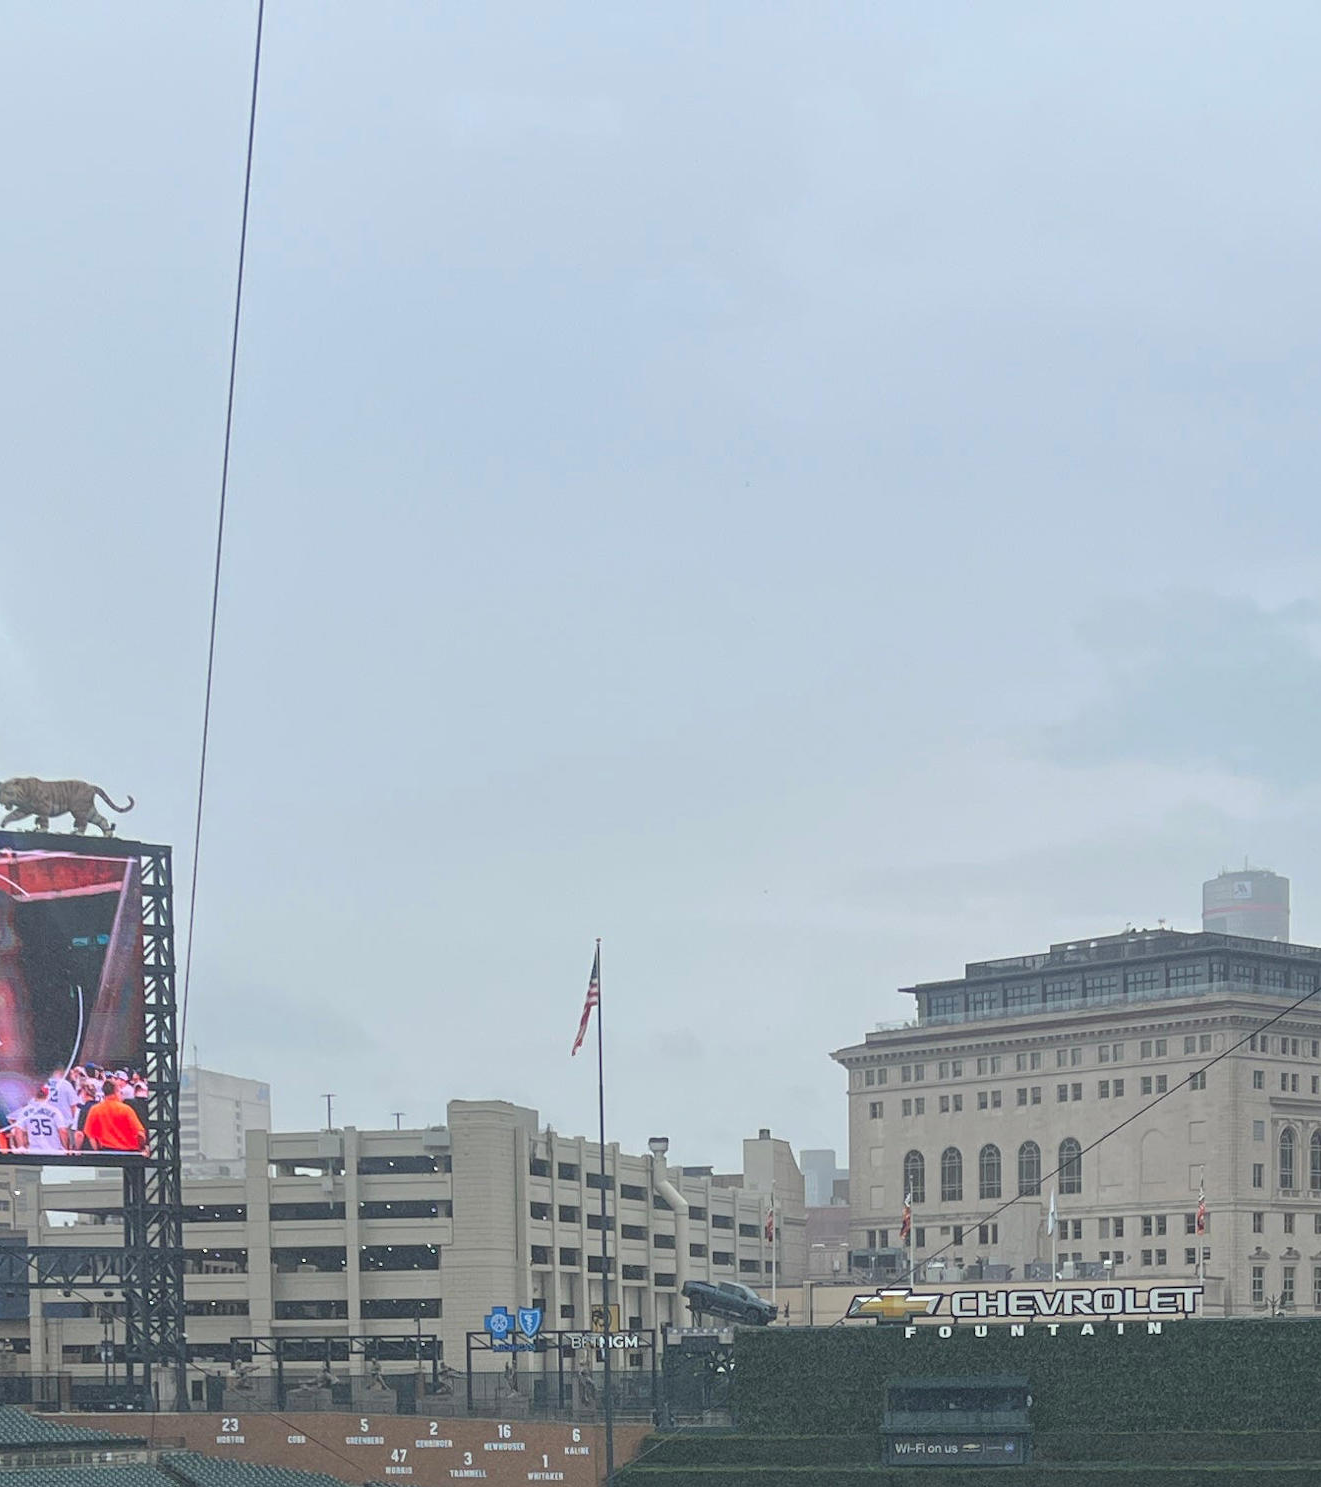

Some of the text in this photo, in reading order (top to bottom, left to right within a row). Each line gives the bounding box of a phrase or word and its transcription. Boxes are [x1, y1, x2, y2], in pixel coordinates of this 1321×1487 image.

[30, 1119, 53, 1137] 35
[950, 1286, 1204, 1318] CHEVROLET
[904, 1322, 1163, 1339] FOUNTAIN
[222, 1418, 239, 1432] 23
[360, 1418, 369, 1432] 5
[429, 1422, 438, 1435] 2
[498, 1424, 511, 1438] 16
[572, 1428, 581, 1442] 6
[895, 1442, 958, 1454] Wi-Fi on us
[391, 1449, 407, 1462] 47
[464, 1452, 472, 1466] 3
[542, 1454, 548, 1468] 1
